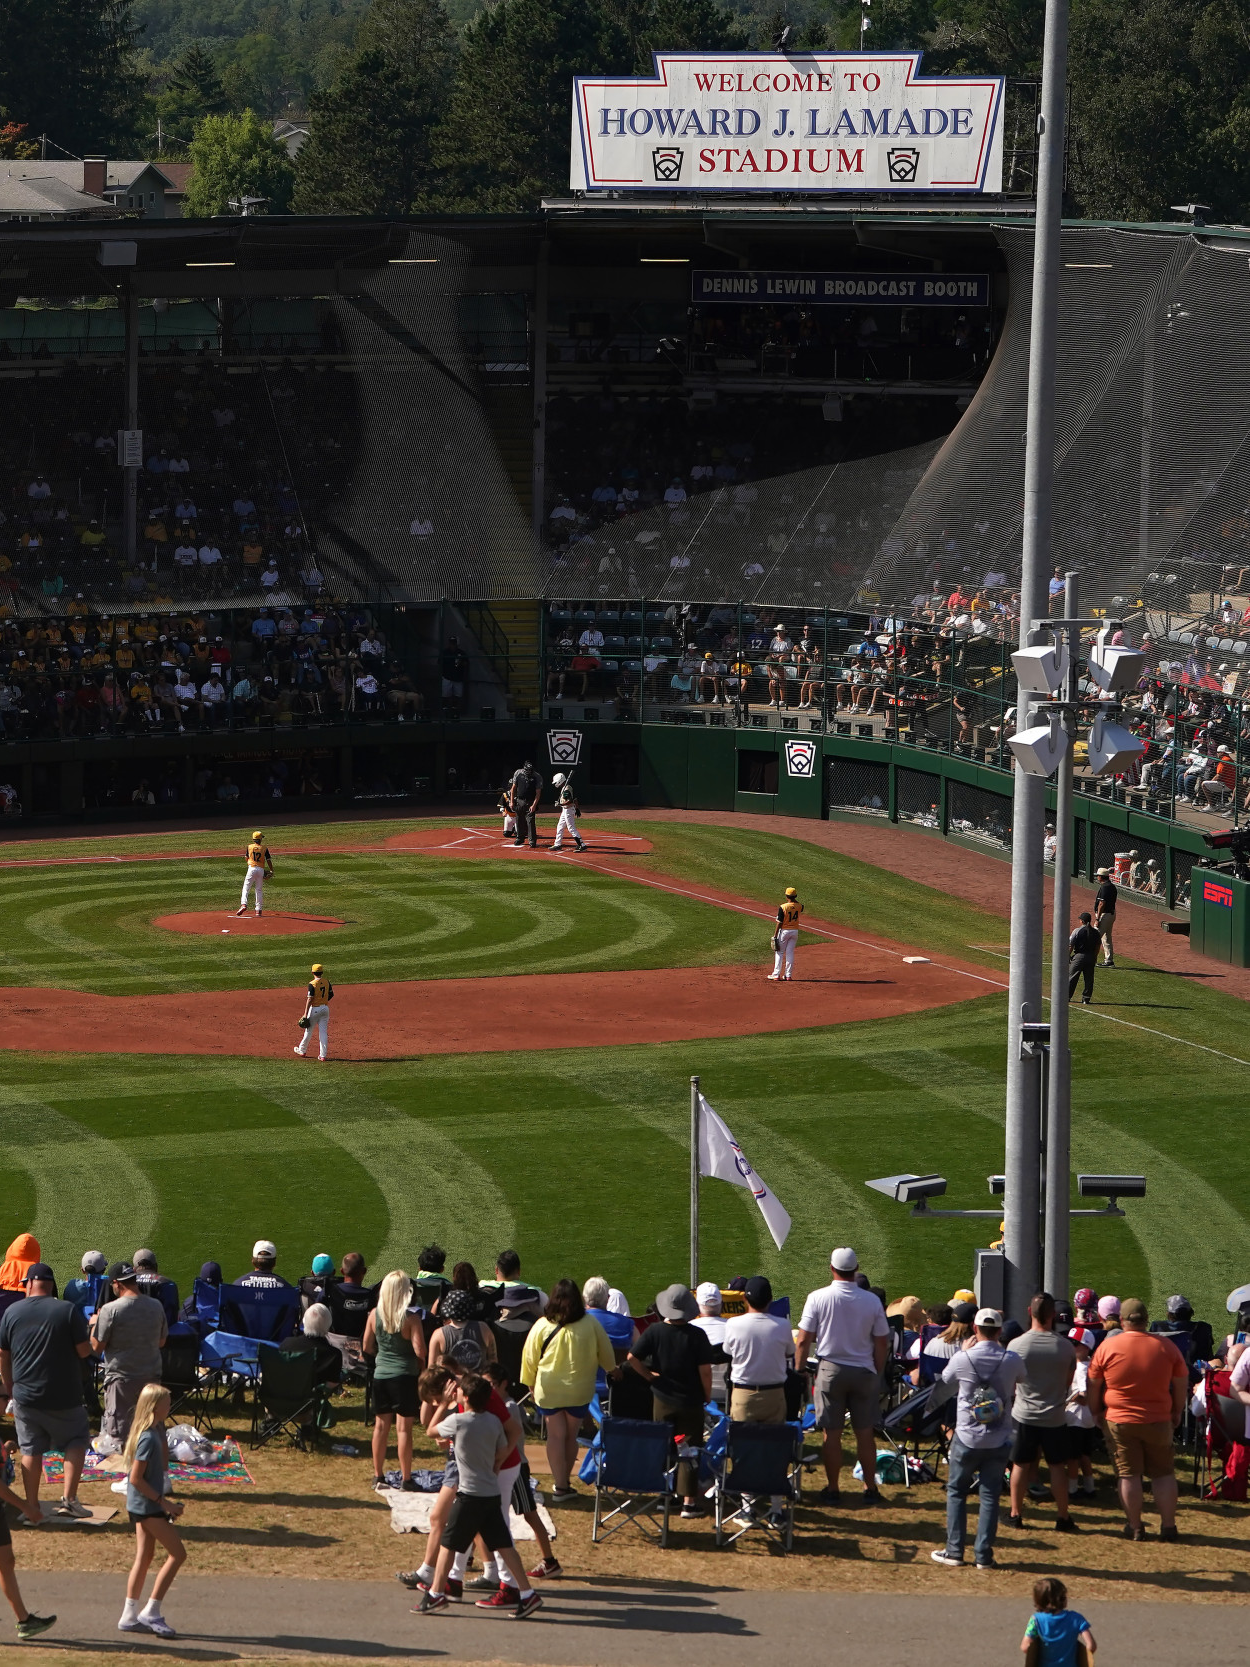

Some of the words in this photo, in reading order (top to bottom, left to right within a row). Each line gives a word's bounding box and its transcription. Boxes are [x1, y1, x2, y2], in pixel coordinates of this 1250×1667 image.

[693, 73, 833, 93] WELCOME
[844, 73, 881, 92] TO
[598, 108, 761, 138] HOWARD
[772, 108, 796, 138] J.
[807, 108, 974, 138] LAMADE
[698, 148, 865, 173] STADIUM
[702, 278, 759, 294] DENNIS
[766, 279, 816, 295] LEWIN
[824, 280, 917, 296] BROADCAST
[923, 282, 978, 297] BOOTH
[253, 852, 262, 862] 12
[1204, 881, 1233, 908] ESPN
[788, 911, 799, 922] 14
[319, 986, 326, 998] 7
